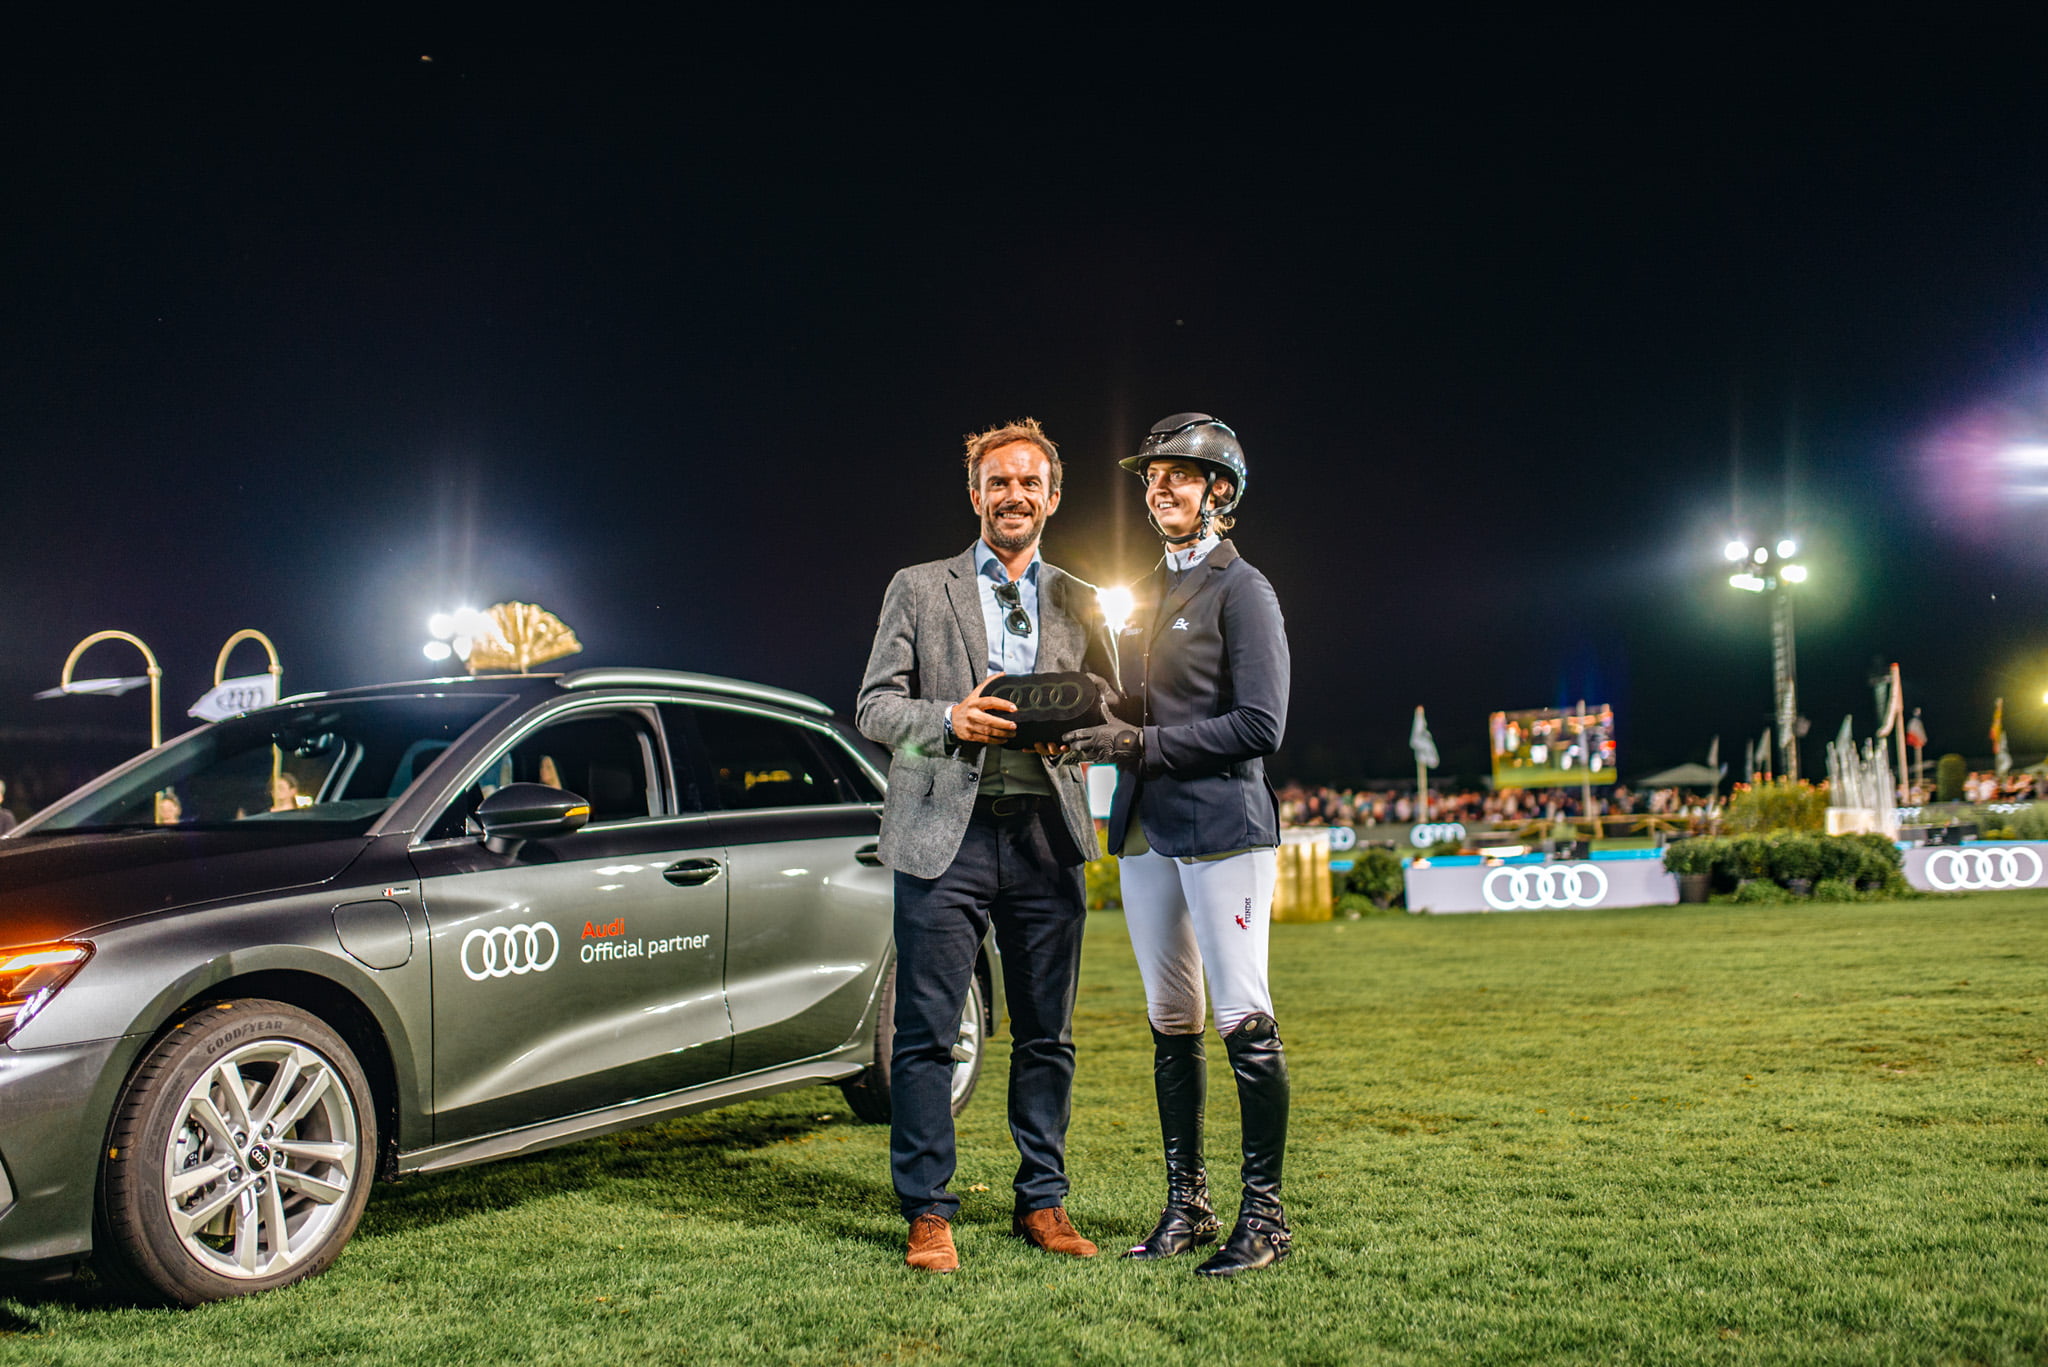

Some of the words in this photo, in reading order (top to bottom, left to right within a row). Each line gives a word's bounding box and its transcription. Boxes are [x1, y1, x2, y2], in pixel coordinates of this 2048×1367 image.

[580, 917, 625, 940] Audi
[580, 938, 644, 963] Official
[648, 933, 710, 959] partner
[206, 1020, 283, 1054] GOODYEAR
